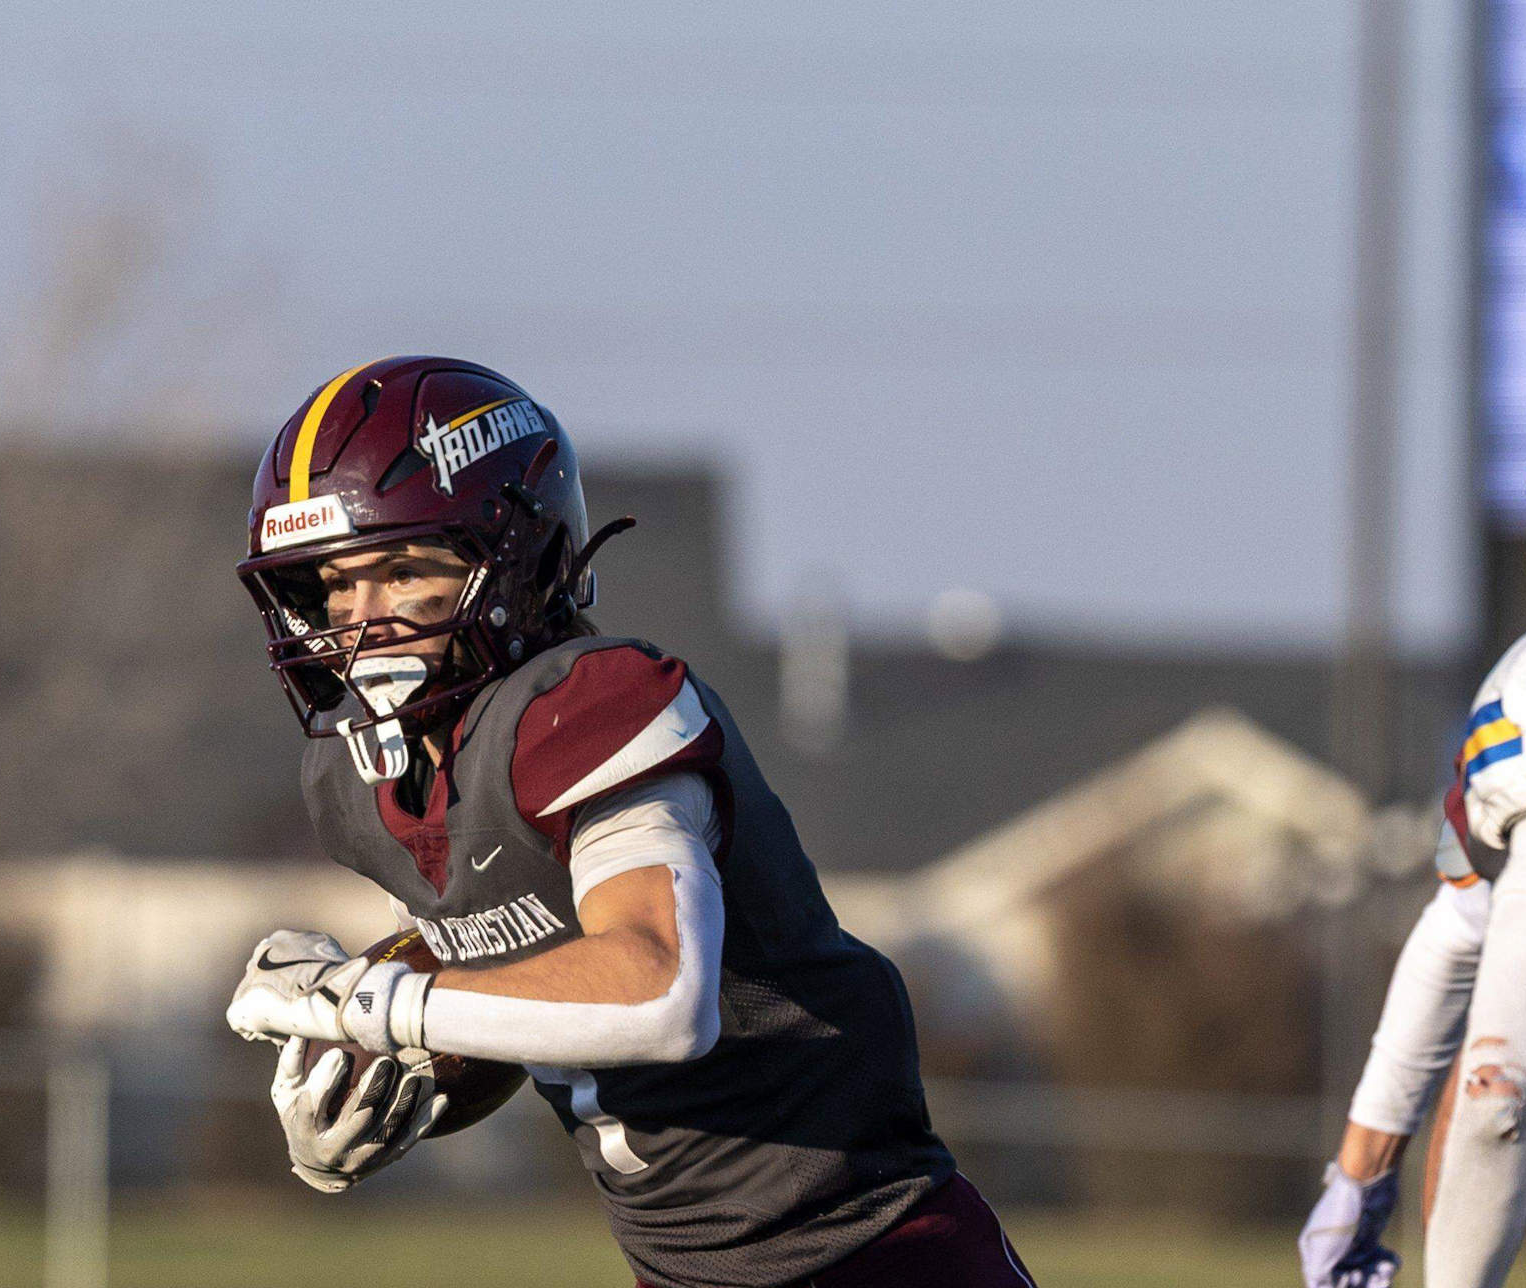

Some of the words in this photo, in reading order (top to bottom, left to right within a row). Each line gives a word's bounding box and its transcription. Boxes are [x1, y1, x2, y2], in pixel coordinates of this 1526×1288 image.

[419, 411, 547, 495] TROJANS
[266, 506, 335, 538] Riddell
[440, 893, 566, 962] CHRISTIAN
